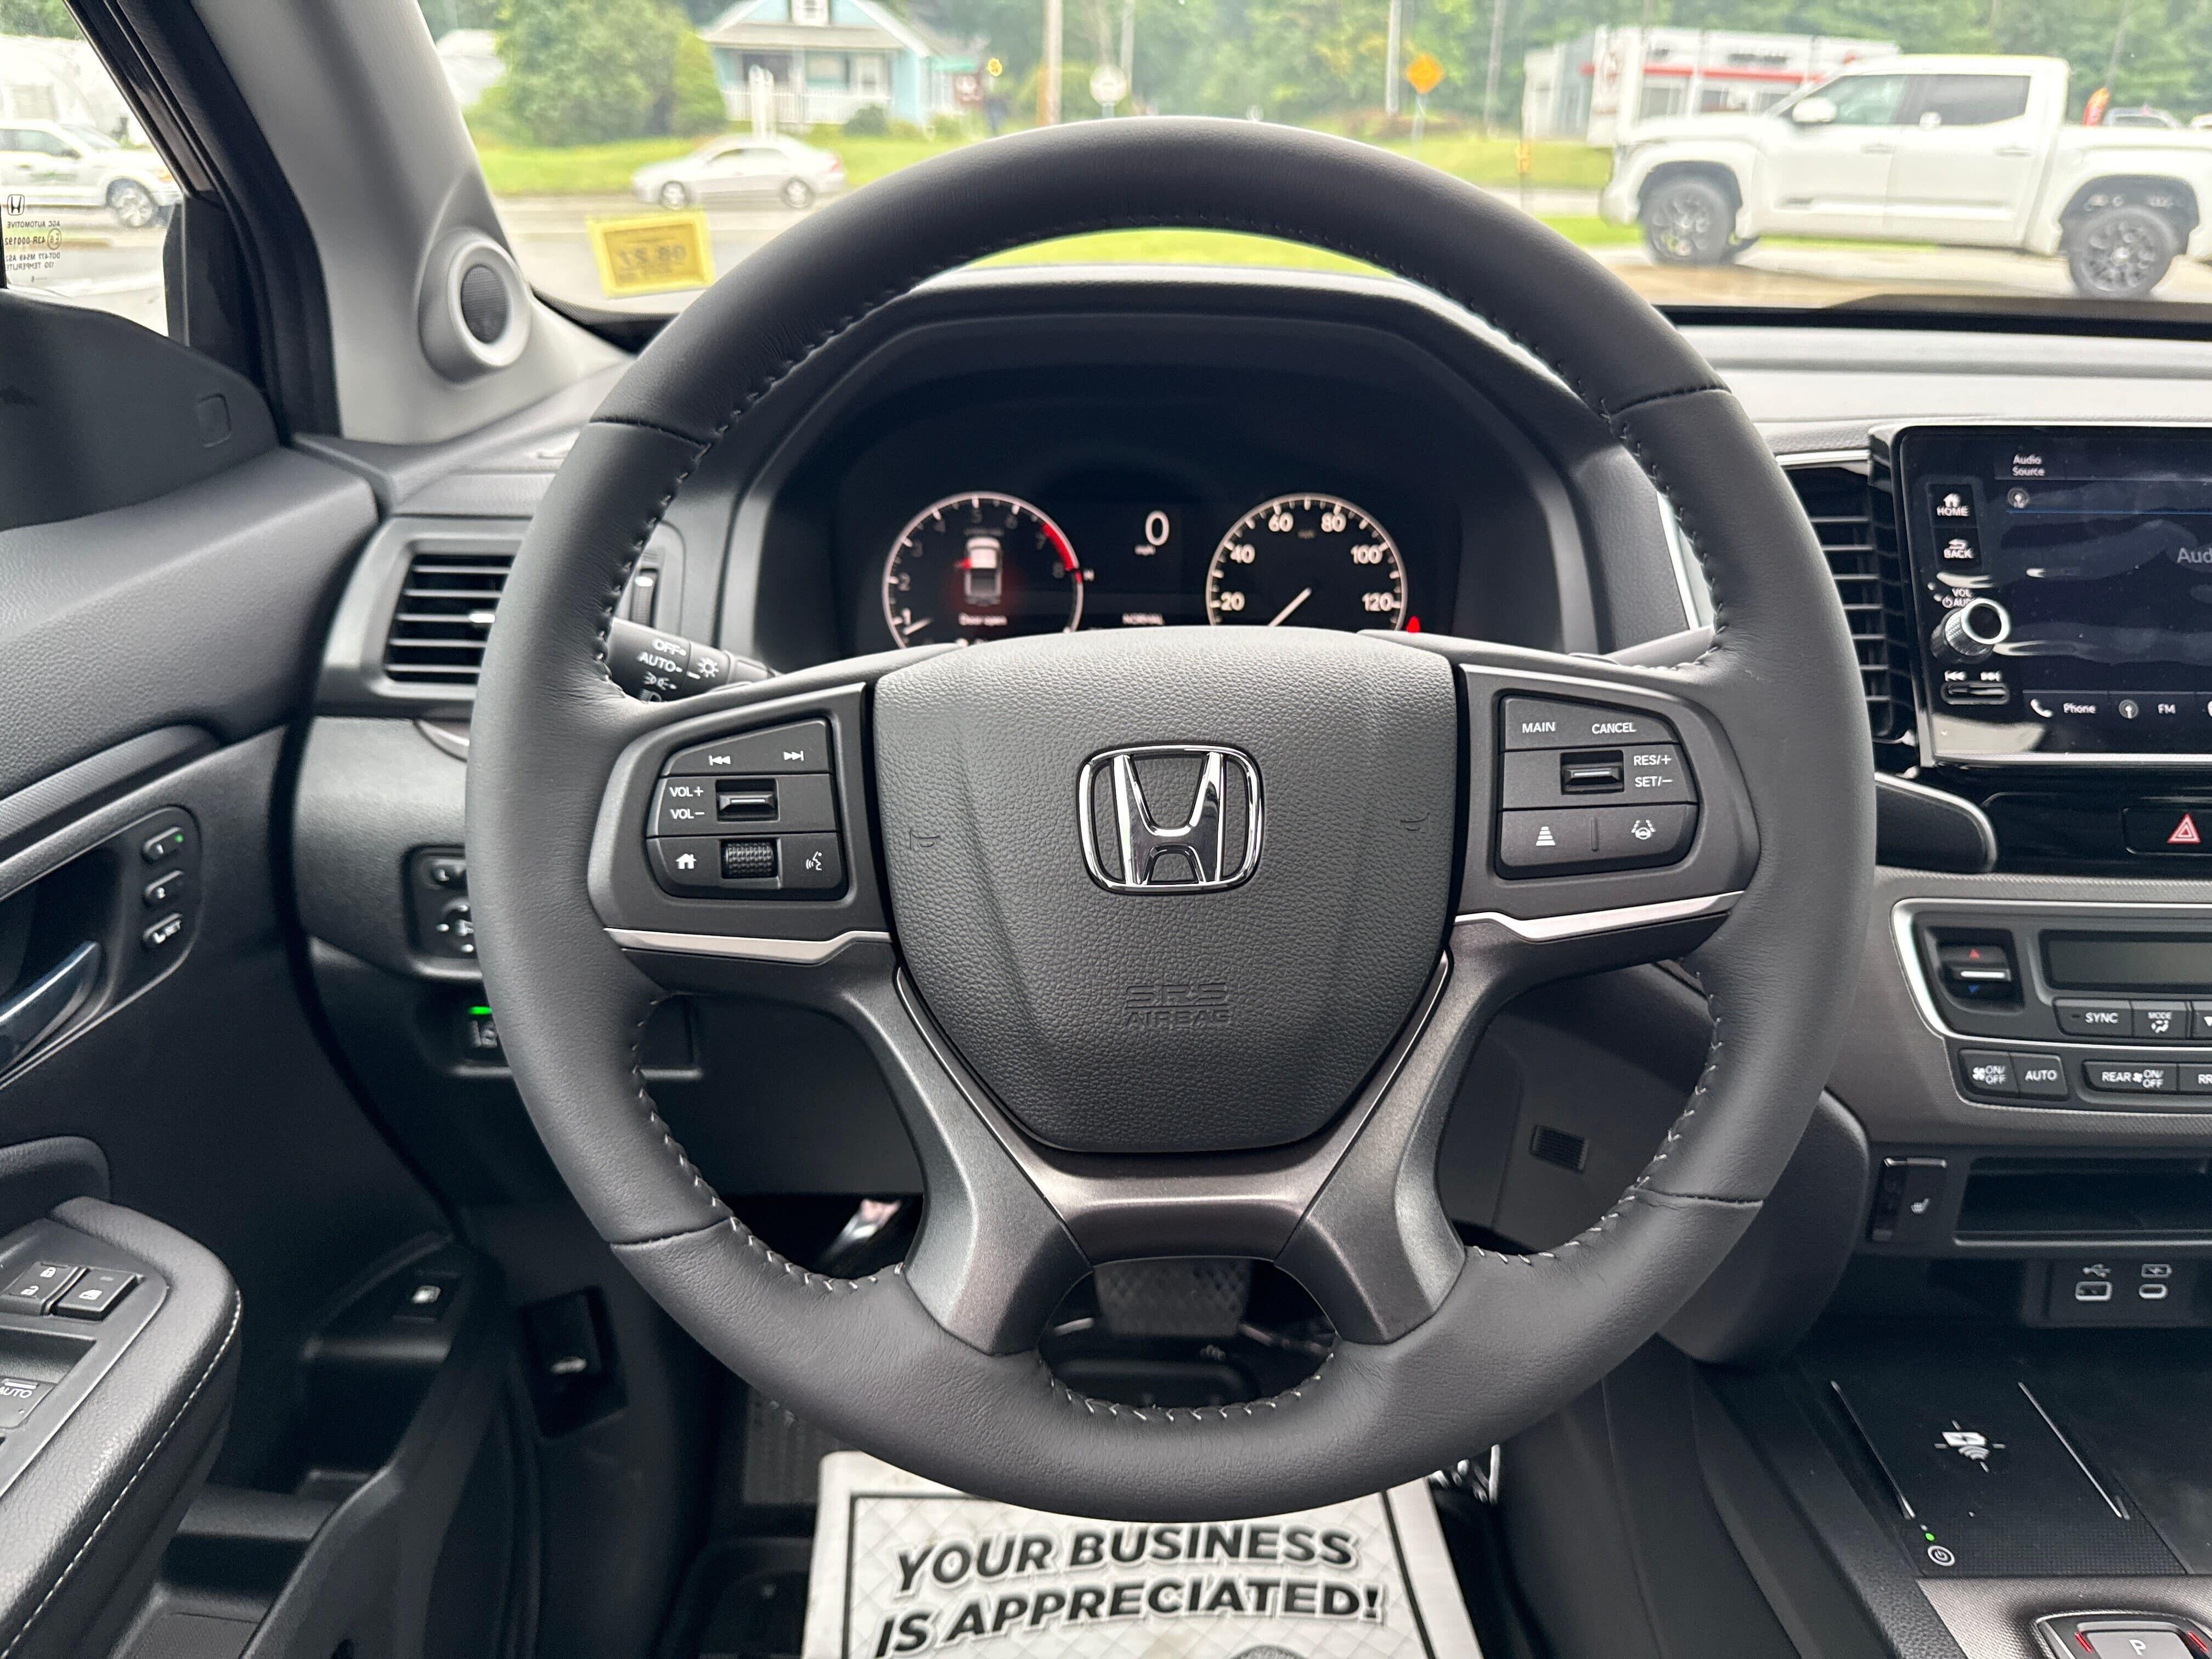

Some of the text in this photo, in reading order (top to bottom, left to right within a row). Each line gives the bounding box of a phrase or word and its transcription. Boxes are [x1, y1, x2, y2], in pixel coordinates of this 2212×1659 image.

[2013, 454, 2042, 465] Audio
[2012, 466, 2046, 477] Source
[1937, 506, 1971, 517] HOME
[1145, 510, 1170, 546] 0
[1268, 512, 1294, 532] 60
[1321, 512, 1346, 533] 80
[1230, 544, 1255, 564] 40
[1350, 544, 1383, 565] 100
[1944, 548, 1975, 558] BACK
[897, 572, 911, 591] 2
[1951, 588, 1973, 597] VOL
[1220, 591, 1245, 612] 20
[1362, 592, 1394, 612] 120
[902, 608, 911, 625] 1
[653, 638, 681, 655] OFF
[638, 651, 676, 673] AUTO
[2063, 702, 2097, 714] Phone
[2158, 703, 2176, 714] FM
[1522, 721, 1556, 733] MAIN
[1592, 722, 1637, 734] CANCEL
[1633, 754, 1672, 766] RES/+
[1126, 982, 1228, 1005] SRS
[1125, 1010, 1232, 1029] AIRBAG
[2085, 1012, 2119, 1024] SYNC
[2148, 1012, 2172, 1020] MODE
[1985, 1075, 2006, 1085] OFF
[2025, 1070, 2057, 1081] AUTO
[2102, 1071, 2132, 1082] REAR
[2143, 1078, 2164, 1088] OFF
[0, 1386, 32, 1398] AUTO
[898, 1524, 1354, 1592] YOUR BUSINESS
[874, 1576, 1380, 1658] IS APPRECIATED!
[2129, 1639, 2146, 1656] P
